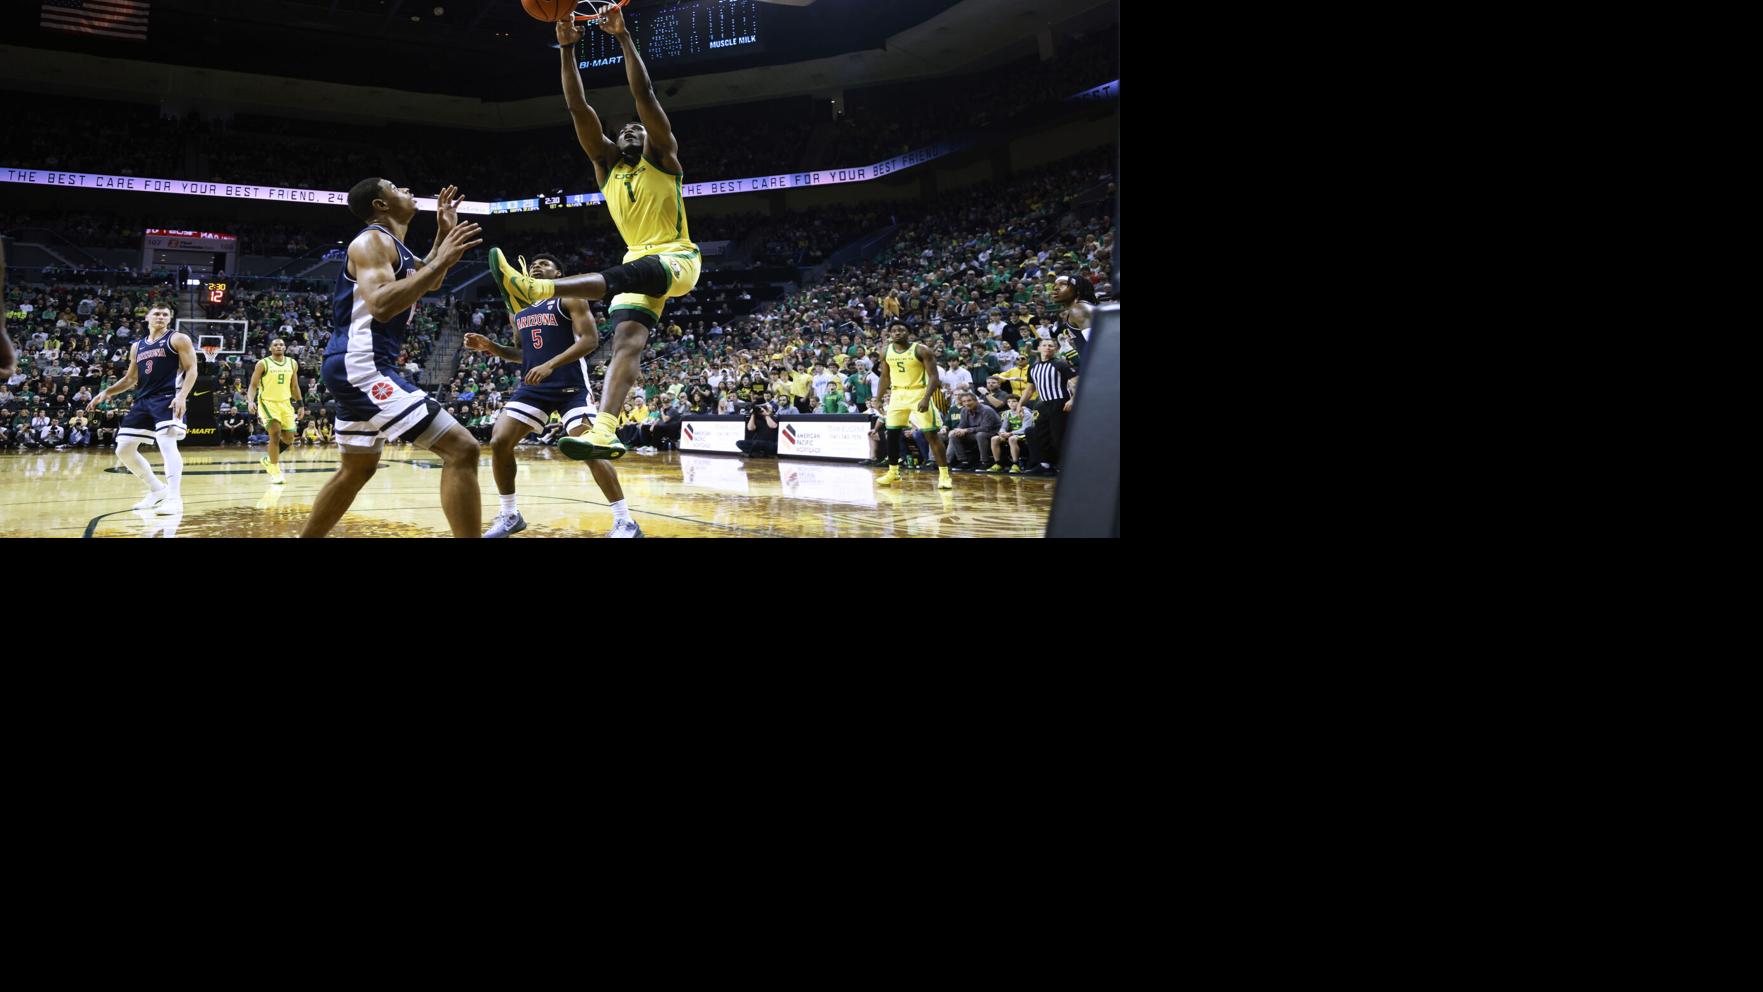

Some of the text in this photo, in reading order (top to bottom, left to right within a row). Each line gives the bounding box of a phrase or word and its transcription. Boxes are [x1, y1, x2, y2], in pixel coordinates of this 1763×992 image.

[710, 35, 757, 49] MUSCLE MILK
[8, 170, 37, 182] THE
[48, 173, 86, 186] BEST
[96, 176, 135, 189] CARE
[145, 180, 171, 191] FOR
[182, 183, 217, 194] YOUR
[226, 186, 260, 197] BEST
[711, 180, 743, 194] BEST
[752, 177, 786, 190] CARE
[795, 173, 820, 185] FOR
[830, 169, 866, 182] YOUR
[873, 159, 897, 177] BEST
[624, 181, 637, 203] 1
[208, 283, 226, 291] 2:30
[210, 290, 223, 303] 12
[517, 313, 559, 330] ARIZONA
[531, 328, 544, 350] 5
[145, 359, 154, 375] 3
[896, 361, 906, 373] 5
[278, 374, 285, 384] 9
